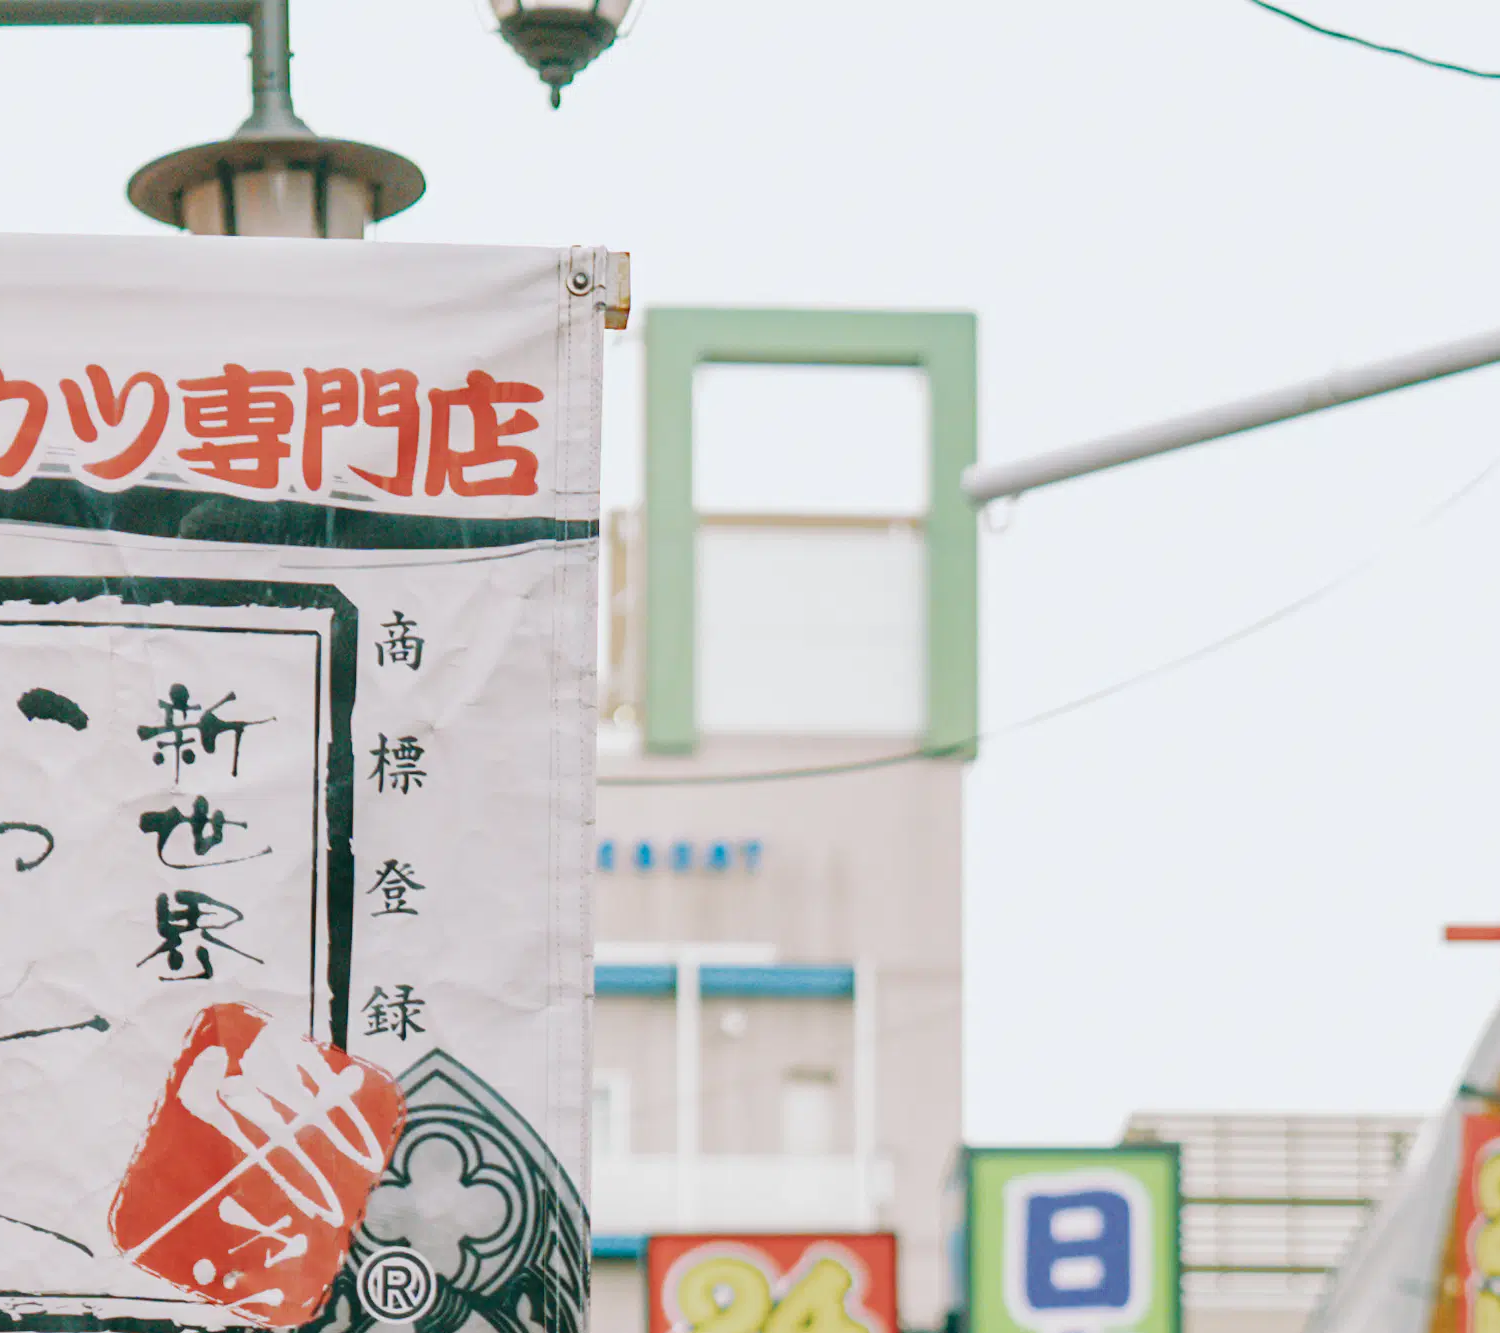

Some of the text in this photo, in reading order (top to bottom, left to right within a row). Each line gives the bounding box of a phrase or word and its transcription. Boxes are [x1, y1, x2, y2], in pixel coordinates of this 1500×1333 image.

[136, 682, 278, 981] 新世界
[361, 608, 428, 1041] 商標登録
